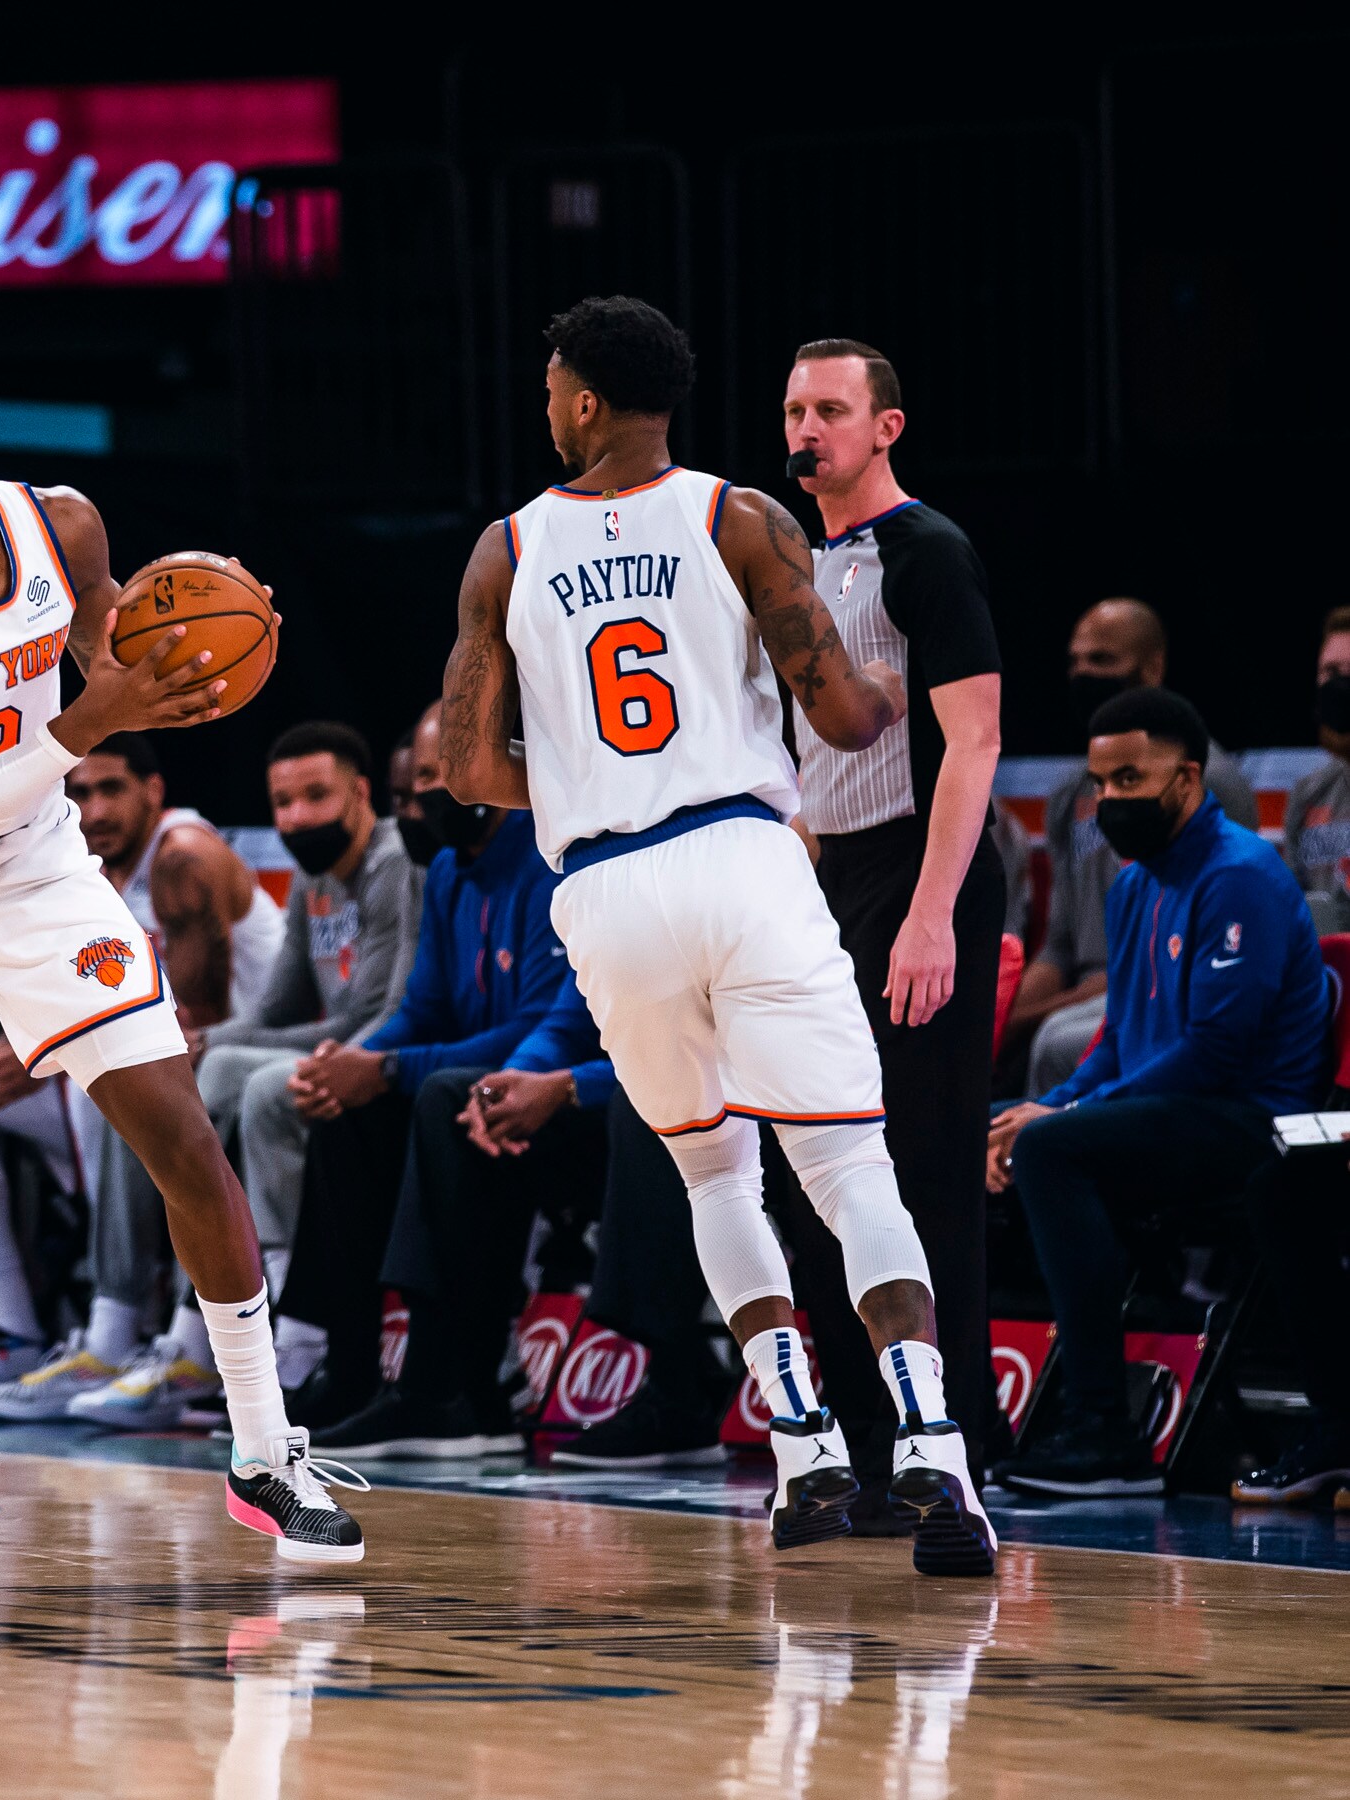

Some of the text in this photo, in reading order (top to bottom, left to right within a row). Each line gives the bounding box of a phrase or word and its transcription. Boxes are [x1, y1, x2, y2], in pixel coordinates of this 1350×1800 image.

[548, 554, 681, 617] PAYTON
[585, 616, 681, 758] 6
[77, 937, 136, 978] KNICKS
[570, 1347, 632, 1403] KIA
